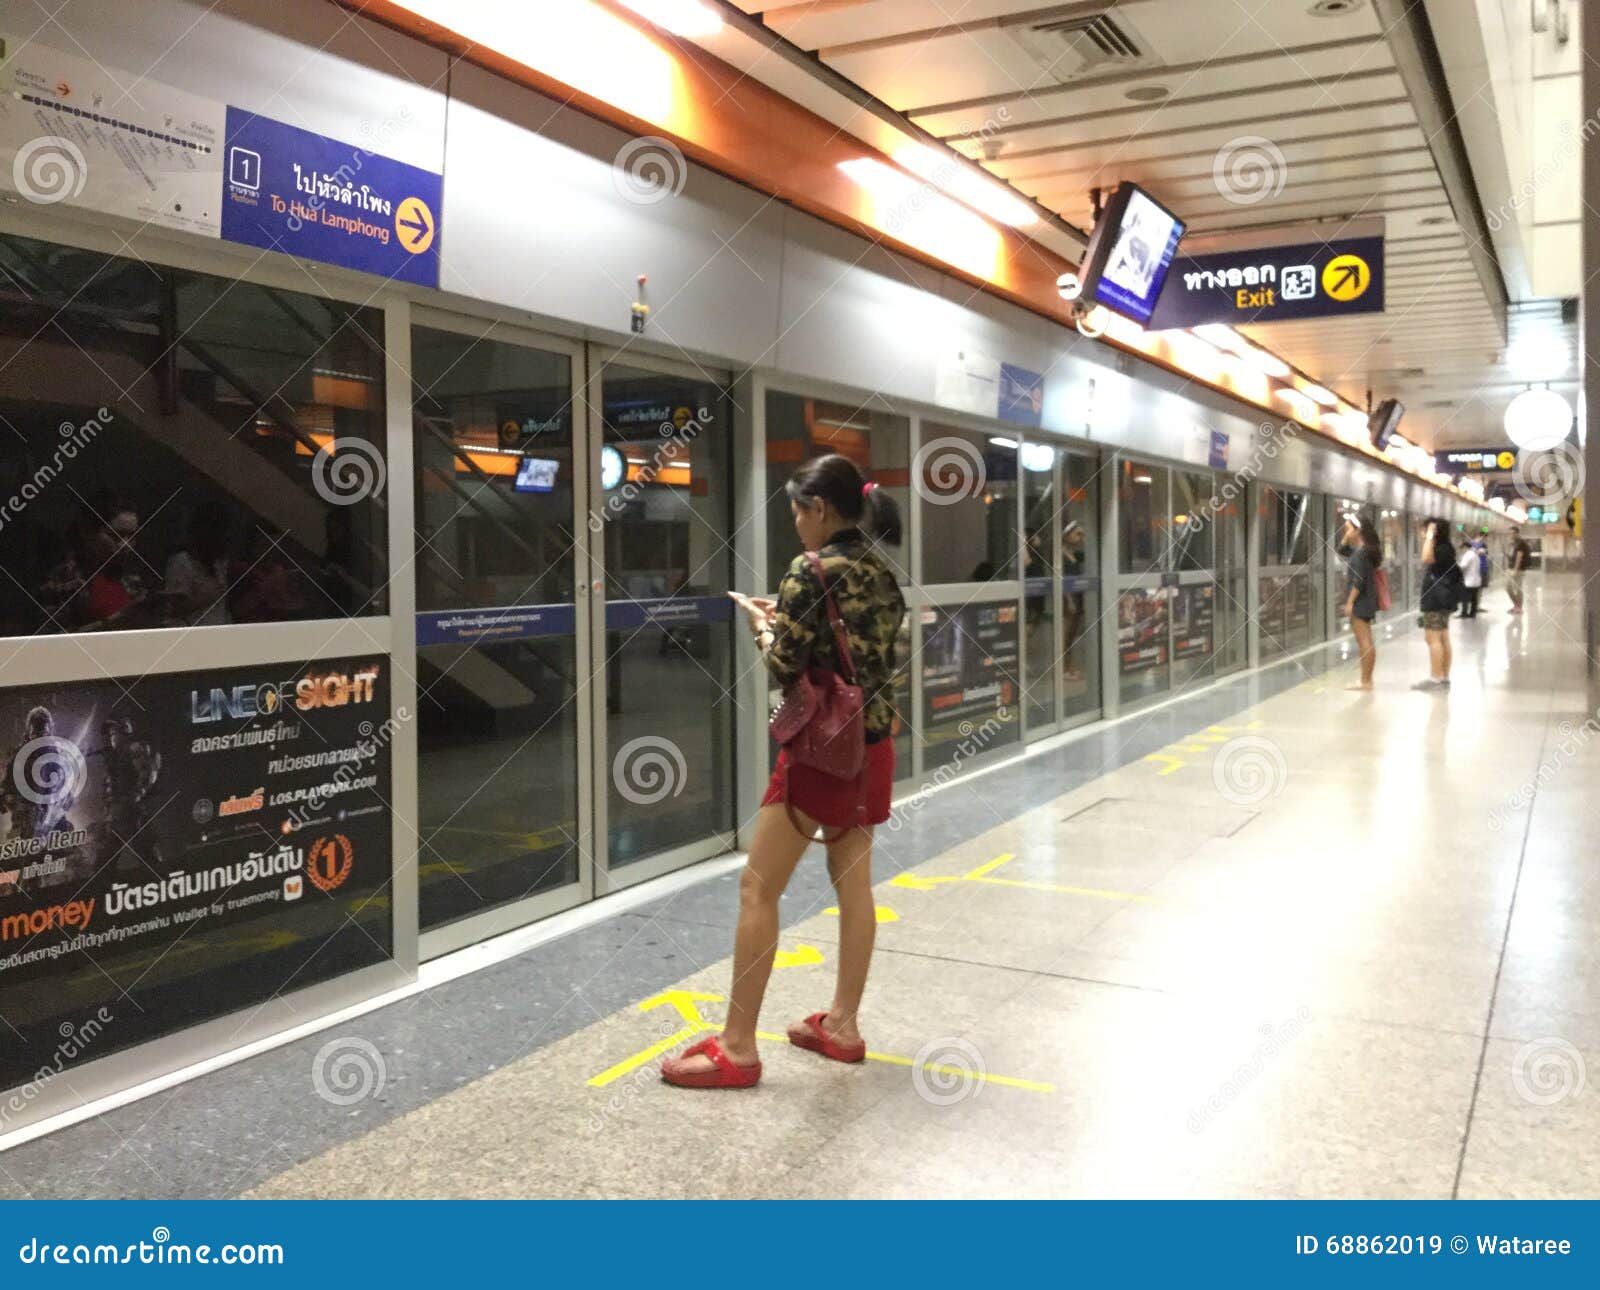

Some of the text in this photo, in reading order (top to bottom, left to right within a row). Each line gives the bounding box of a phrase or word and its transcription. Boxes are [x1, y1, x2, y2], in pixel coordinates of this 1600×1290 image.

[242, 159, 249, 180] 1
[293, 163, 391, 216] ไปหัวลำโพง
[270, 194, 390, 245] To Hua Lamphong
[1183, 264, 1276, 291] ทางออก
[1236, 287, 1275, 309] Exit
[296, 672, 378, 711] SIGHT
[0, 829, 88, 860] sive Item
[105, 840, 336, 916] บัตรเติมเกมอันดับ 1
[2, 897, 95, 942] money
[173, 907, 207, 924] Wallet
[211, 903, 224, 916] by
[227, 889, 280, 910] truemoney
